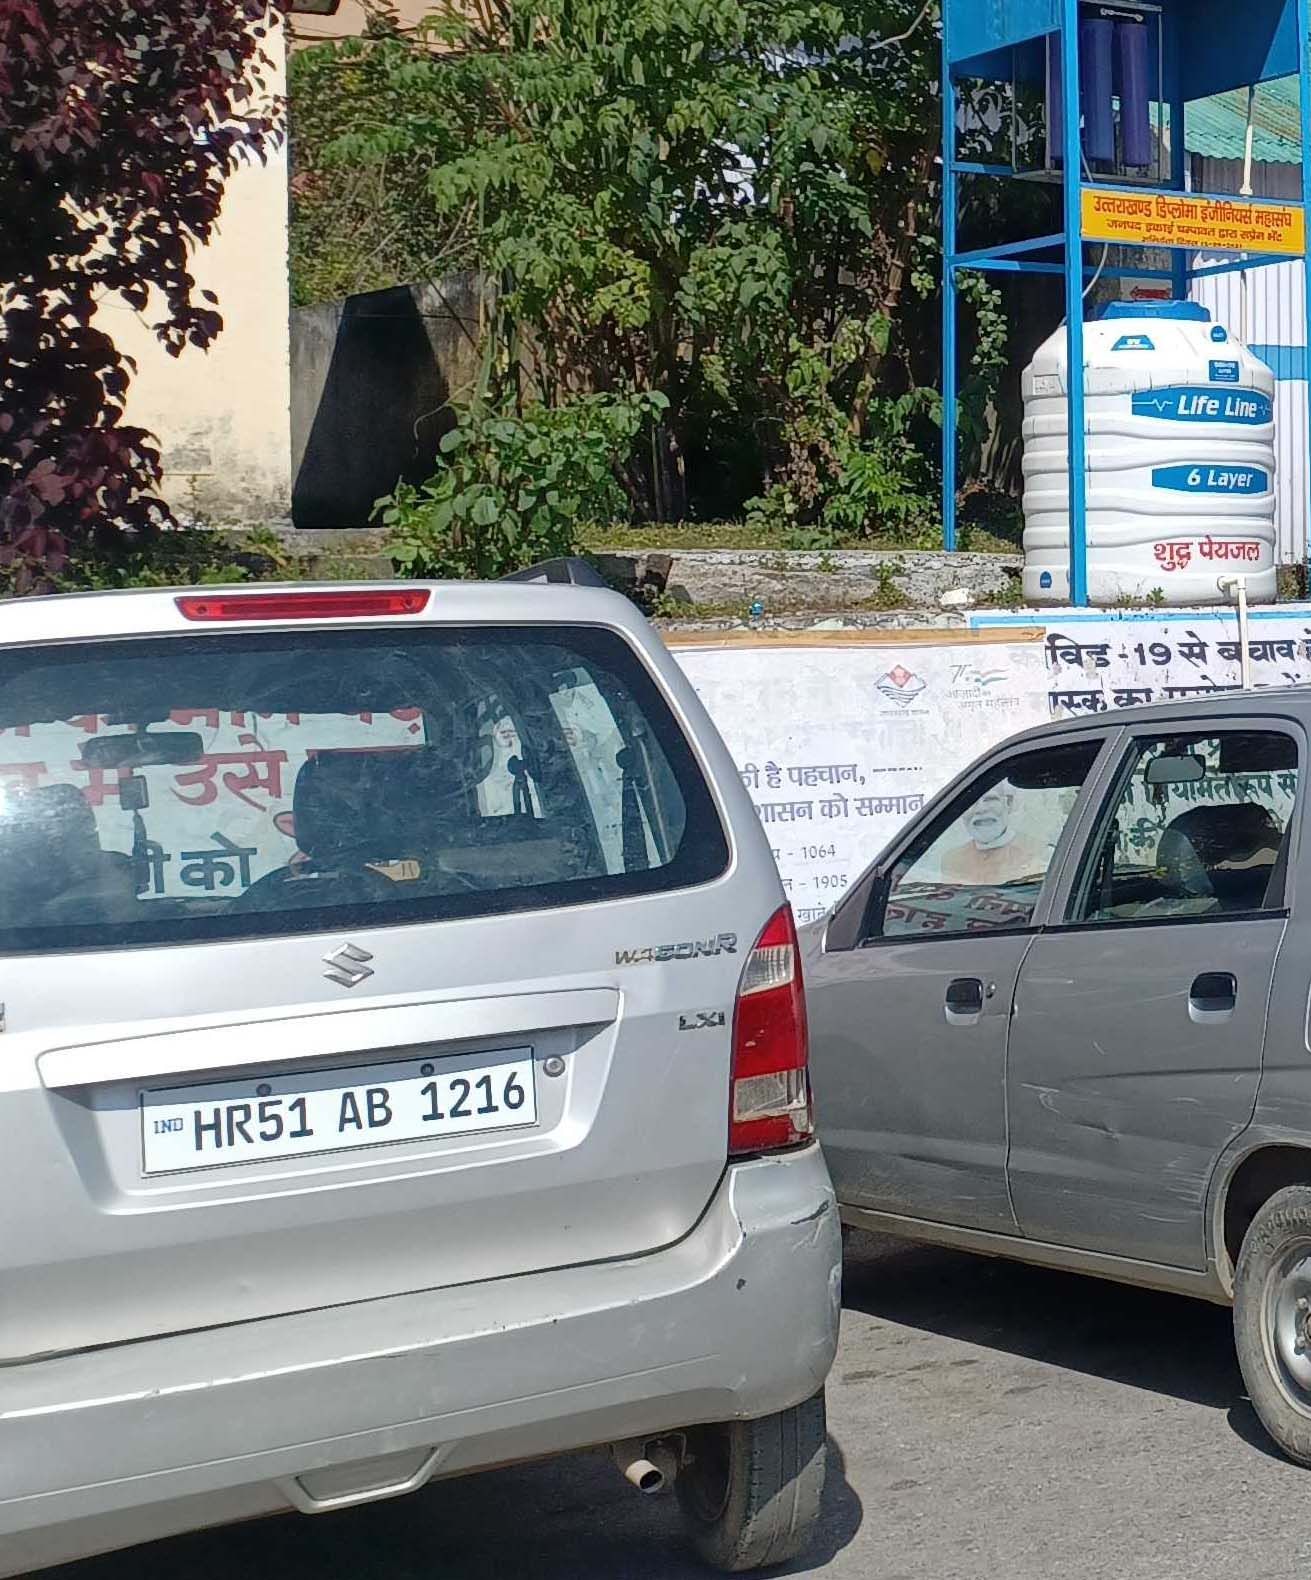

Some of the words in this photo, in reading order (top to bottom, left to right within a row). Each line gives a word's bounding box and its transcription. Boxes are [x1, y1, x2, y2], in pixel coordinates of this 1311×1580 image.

[1177, 394, 1220, 415] Life
[1225, 396, 1257, 418] Line
[1187, 468, 1200, 486] 6
[1207, 469, 1254, 489] Layer
[1198, 534, 1261, 561] पेयजल
[1045, 633, 1110, 669] विड
[1177, 630, 1209, 667] से
[1216, 640, 1297, 664] बचाव
[765, 760, 782, 789] है
[819, 792, 849, 818] को
[854, 793, 925, 817] सम्मान
[180, 831, 257, 891] को
[802, 845, 836, 860] 1064
[813, 875, 848, 889] 1905
[154, 1117, 185, 1135] IND
[193, 1098, 315, 1151] HR51
[338, 1087, 393, 1132] AB
[420, 1071, 525, 1122] 1216
